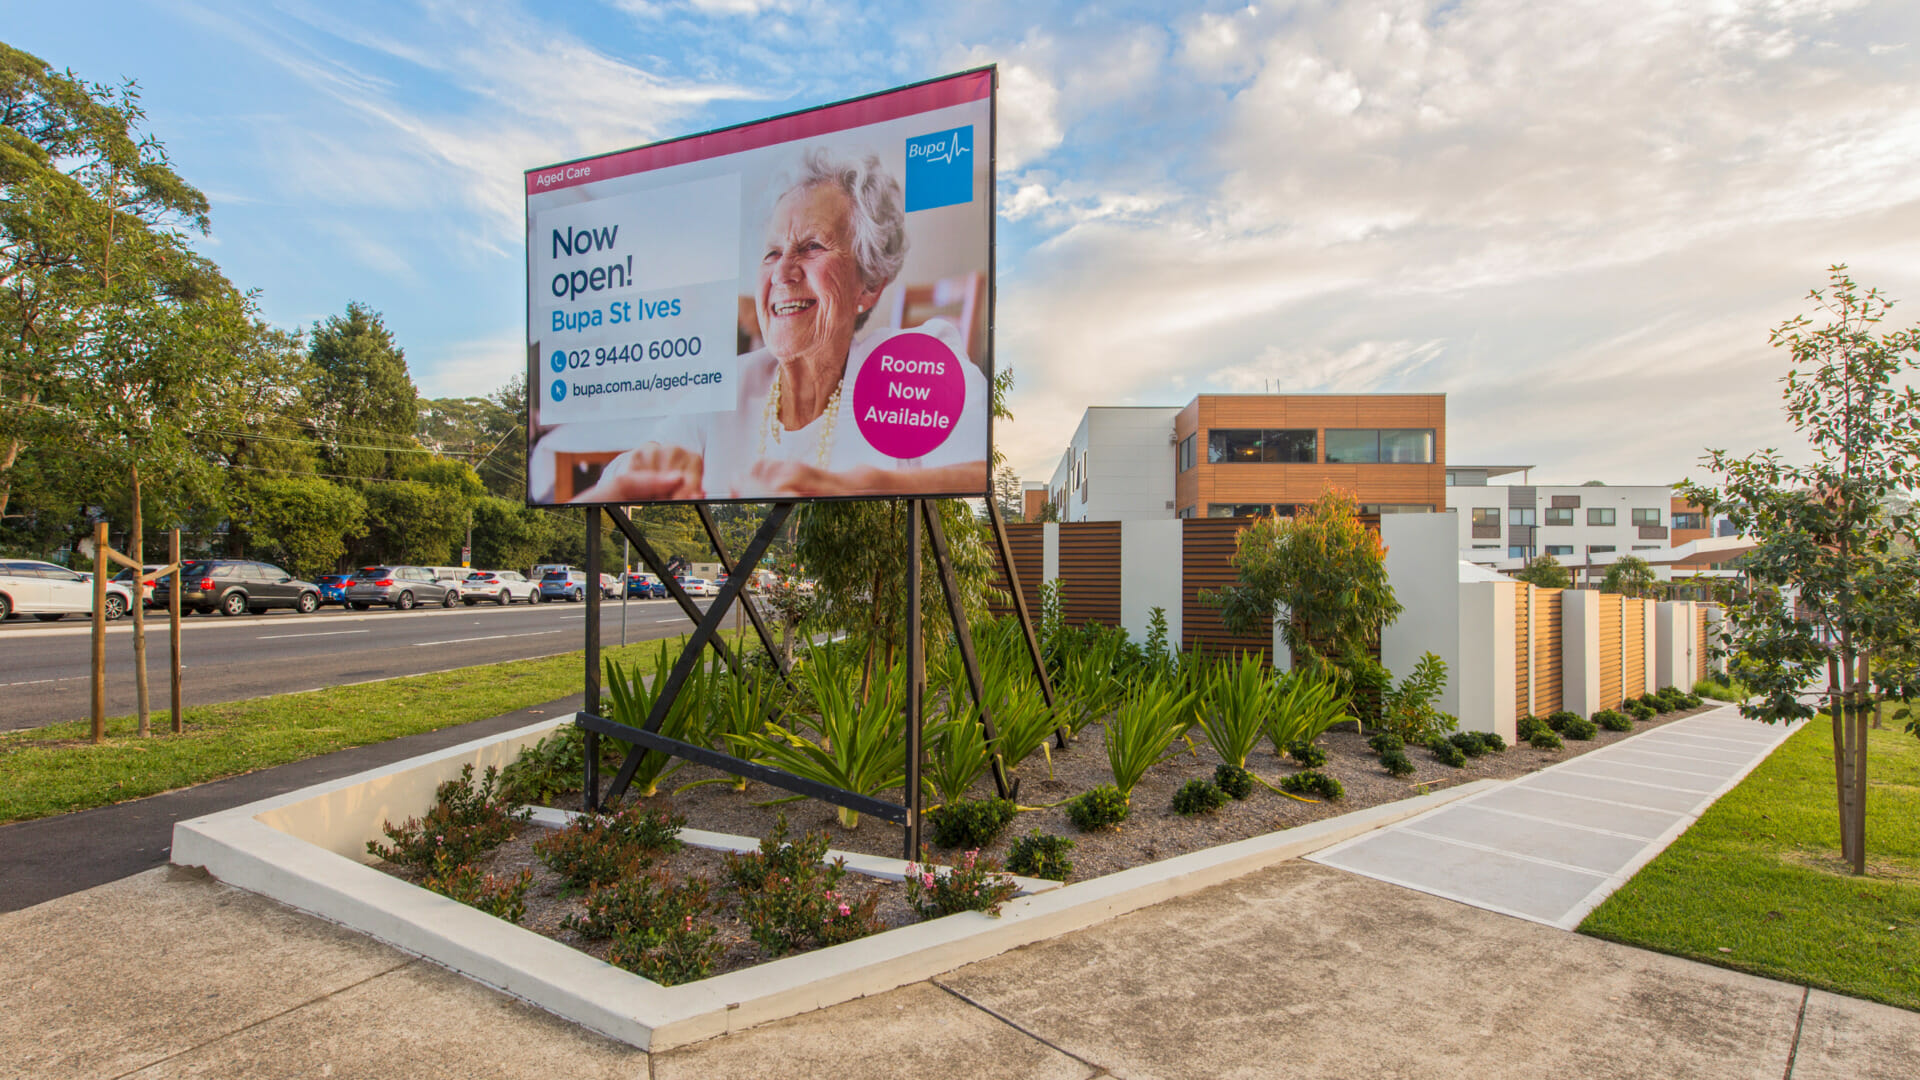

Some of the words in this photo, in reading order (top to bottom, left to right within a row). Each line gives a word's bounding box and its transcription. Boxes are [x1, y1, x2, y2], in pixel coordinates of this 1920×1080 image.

[909, 140, 945, 157] Bupa
[536, 168, 564, 186] Aged
[566, 166, 591, 180] Care
[552, 224, 618, 259] Now
[552, 255, 633, 301] open!
[552, 309, 602, 332] Bupa
[609, 301, 631, 324] St
[638, 298, 681, 320] Ives
[568, 350, 590, 369] 02
[595, 343, 643, 366] 9440
[648, 336, 702, 360] 6000
[880, 355, 945, 375] Rooms
[573, 371, 722, 397] bupa.com.au/aged-care
[888, 382, 930, 401] Now
[864, 406, 949, 429] Available
